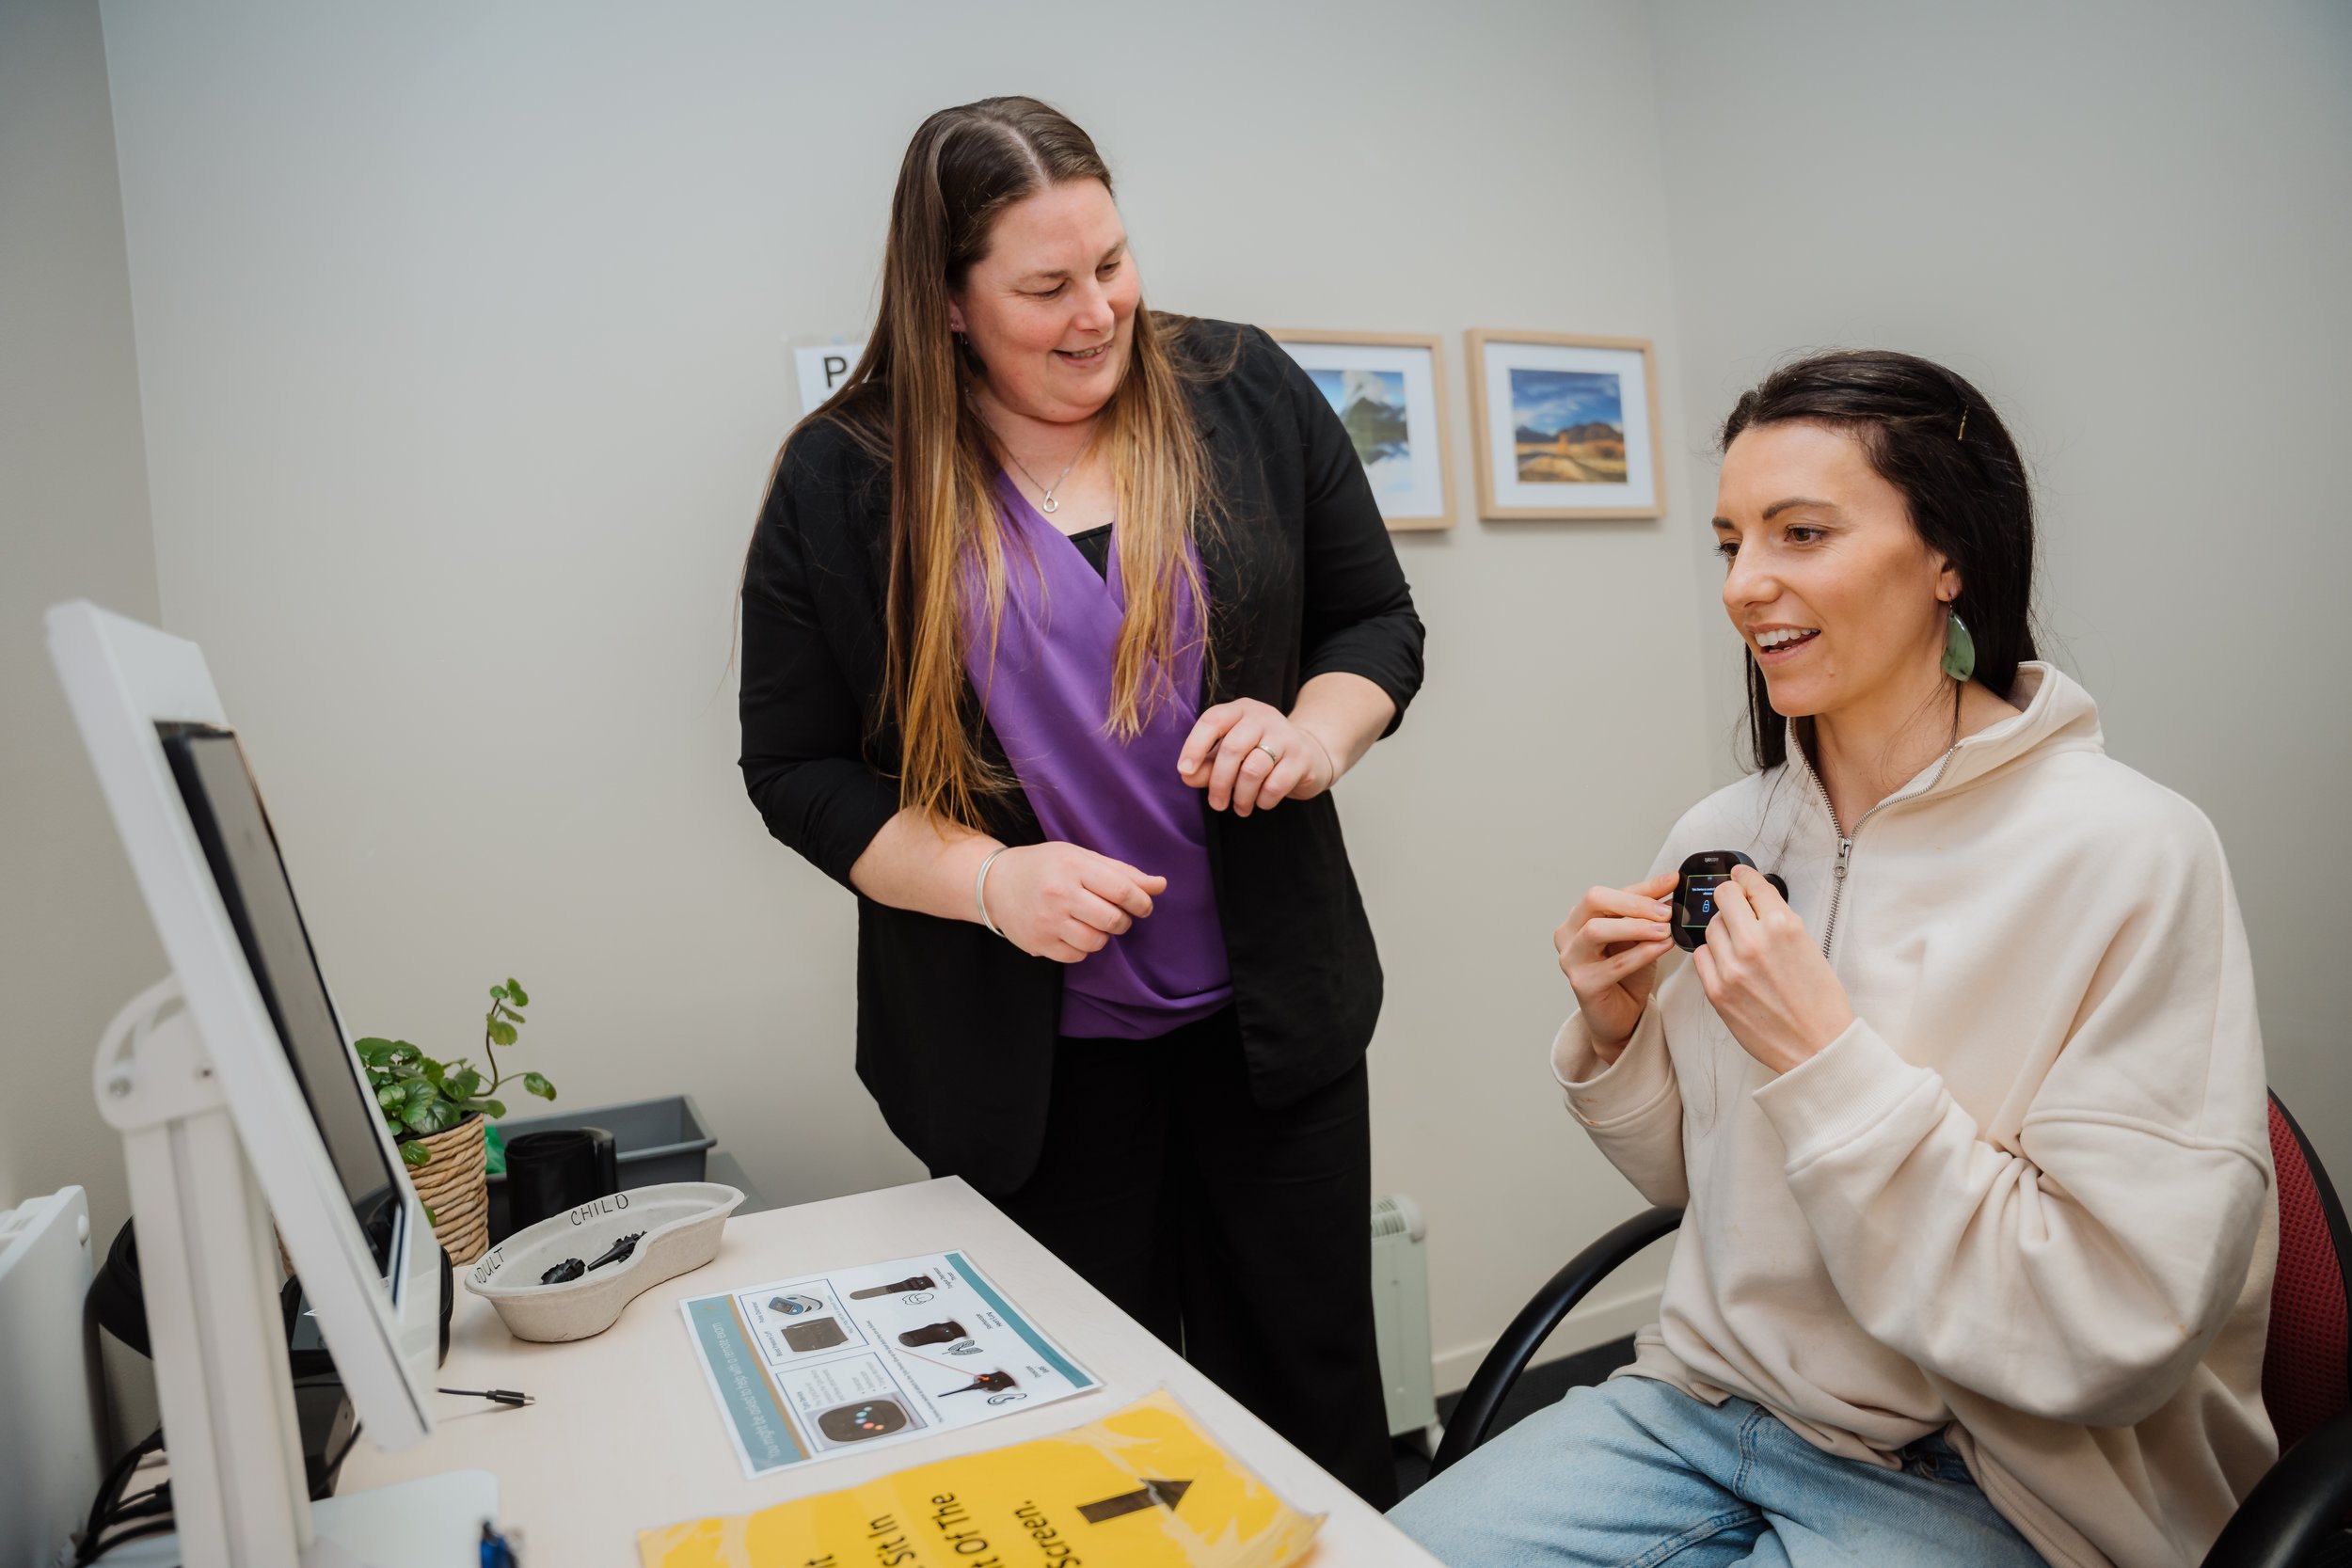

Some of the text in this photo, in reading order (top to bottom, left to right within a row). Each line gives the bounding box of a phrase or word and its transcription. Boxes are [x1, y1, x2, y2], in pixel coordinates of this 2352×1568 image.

[570, 1193, 629, 1226] CHILD
[931, 1492, 971, 1530] The
[867, 1513, 916, 1568] Sit In
[945, 1529, 989, 1556] Of
[1015, 1499, 1081, 1568] Screen.
